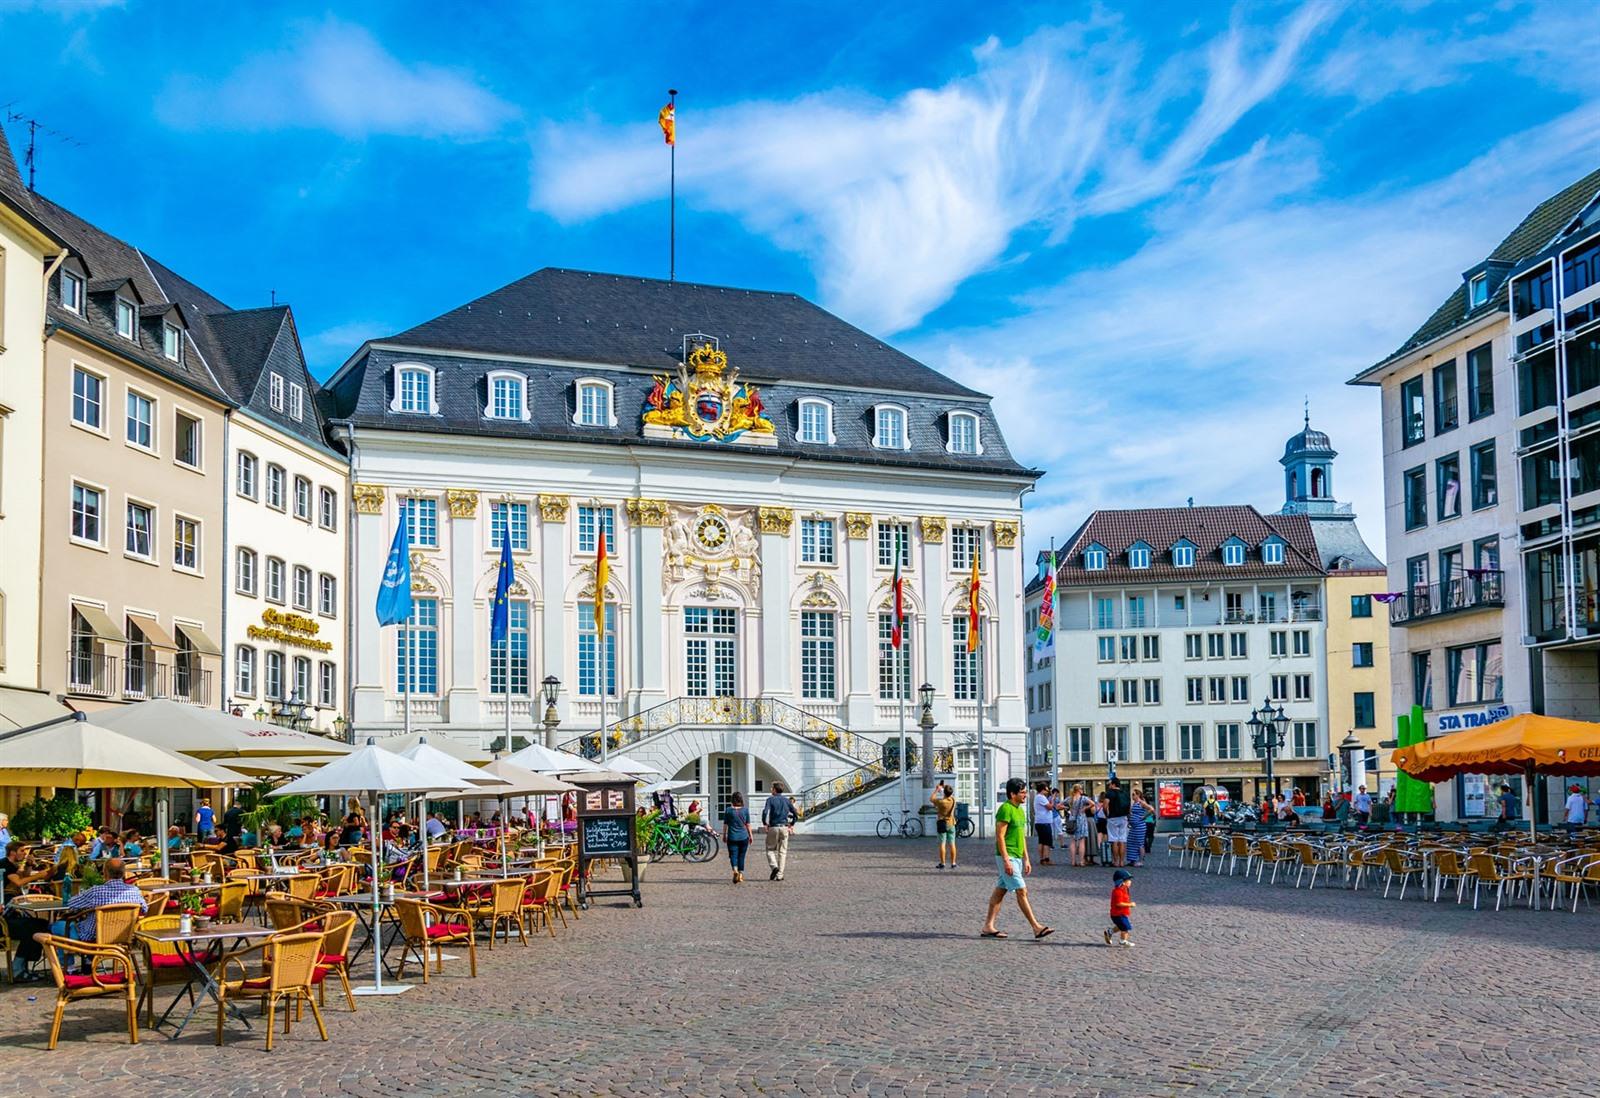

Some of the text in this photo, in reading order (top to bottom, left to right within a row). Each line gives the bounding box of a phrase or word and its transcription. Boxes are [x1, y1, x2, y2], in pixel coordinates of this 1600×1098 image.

[1439, 715, 1461, 730] STA
[1463, 711, 1500, 728] TRA
[1152, 767, 1194, 775] RULAND
